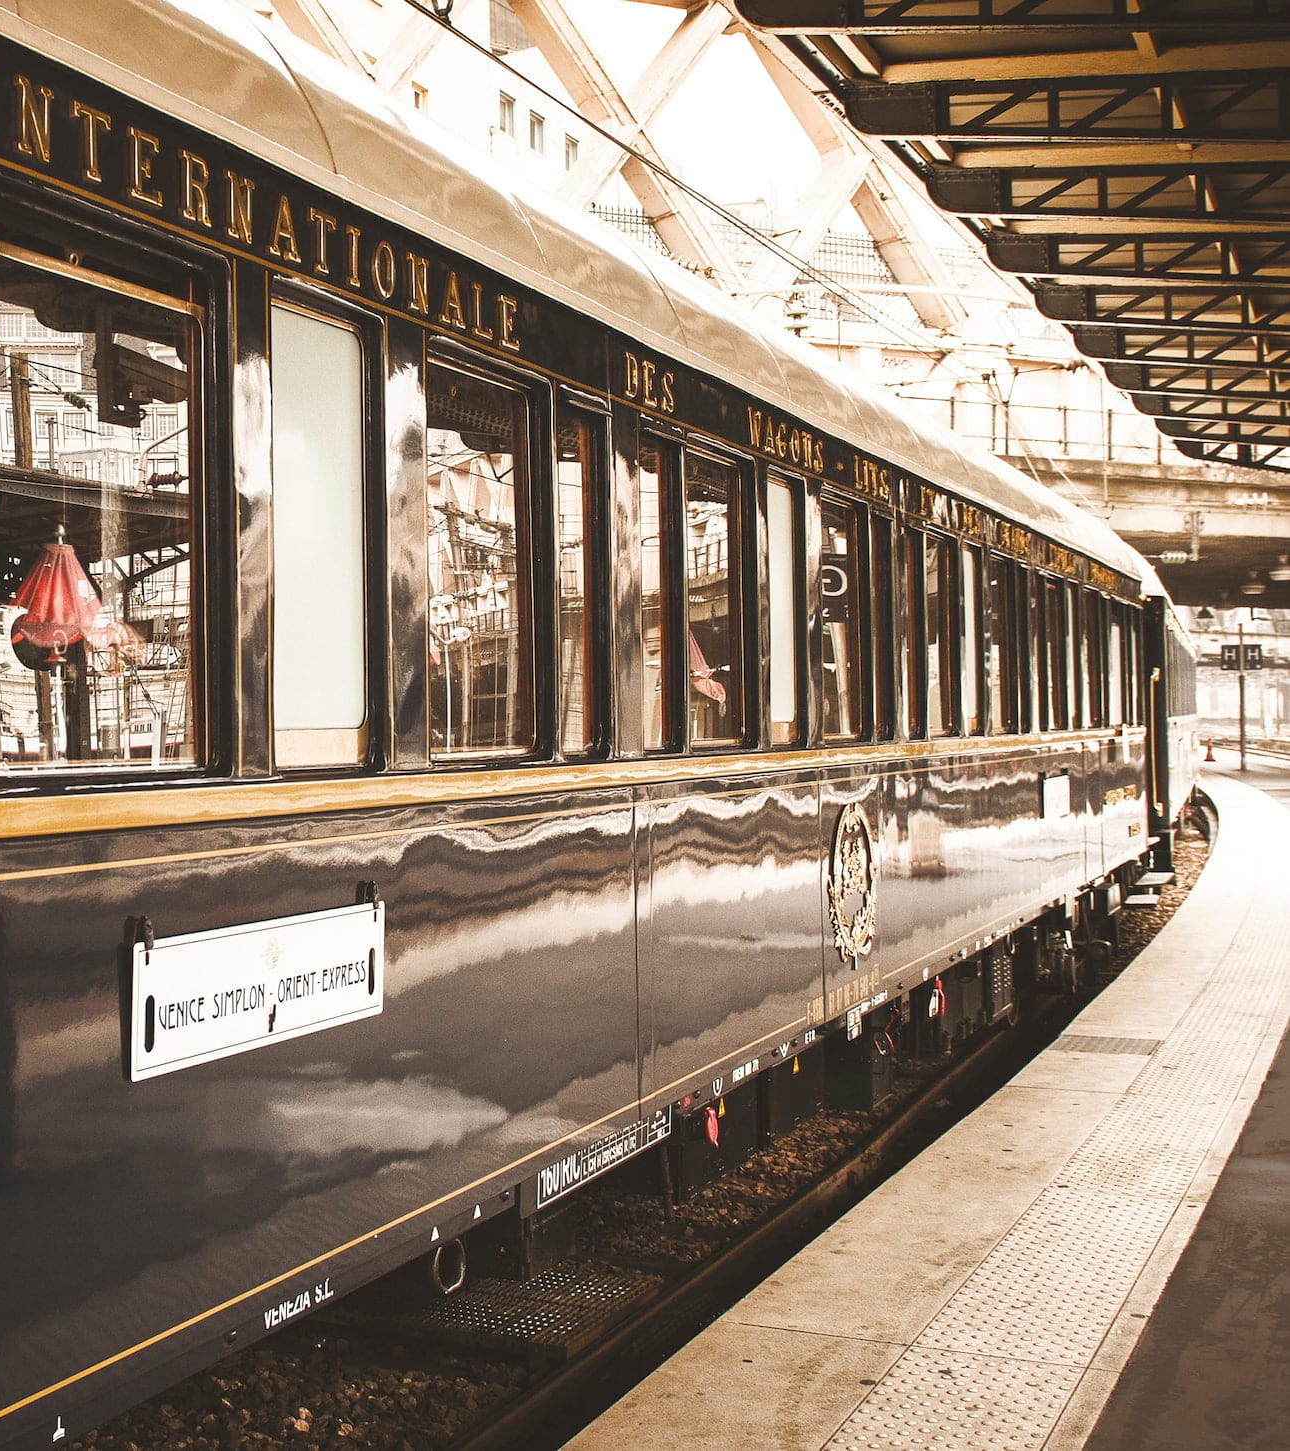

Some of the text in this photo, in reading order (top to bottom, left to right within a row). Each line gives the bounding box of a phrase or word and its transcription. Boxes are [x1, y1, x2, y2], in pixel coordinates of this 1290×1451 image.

[624, 351, 675, 414] DES
[746, 405, 825, 475] WAGONS
[853, 454, 890, 501] LITS
[158, 996, 206, 1031] VENICE
[212, 983, 266, 1020] SIMPLON
[277, 960, 367, 1003] ORIENT-EXPRESS
[264, 1290, 311, 1330] VENEZIA
